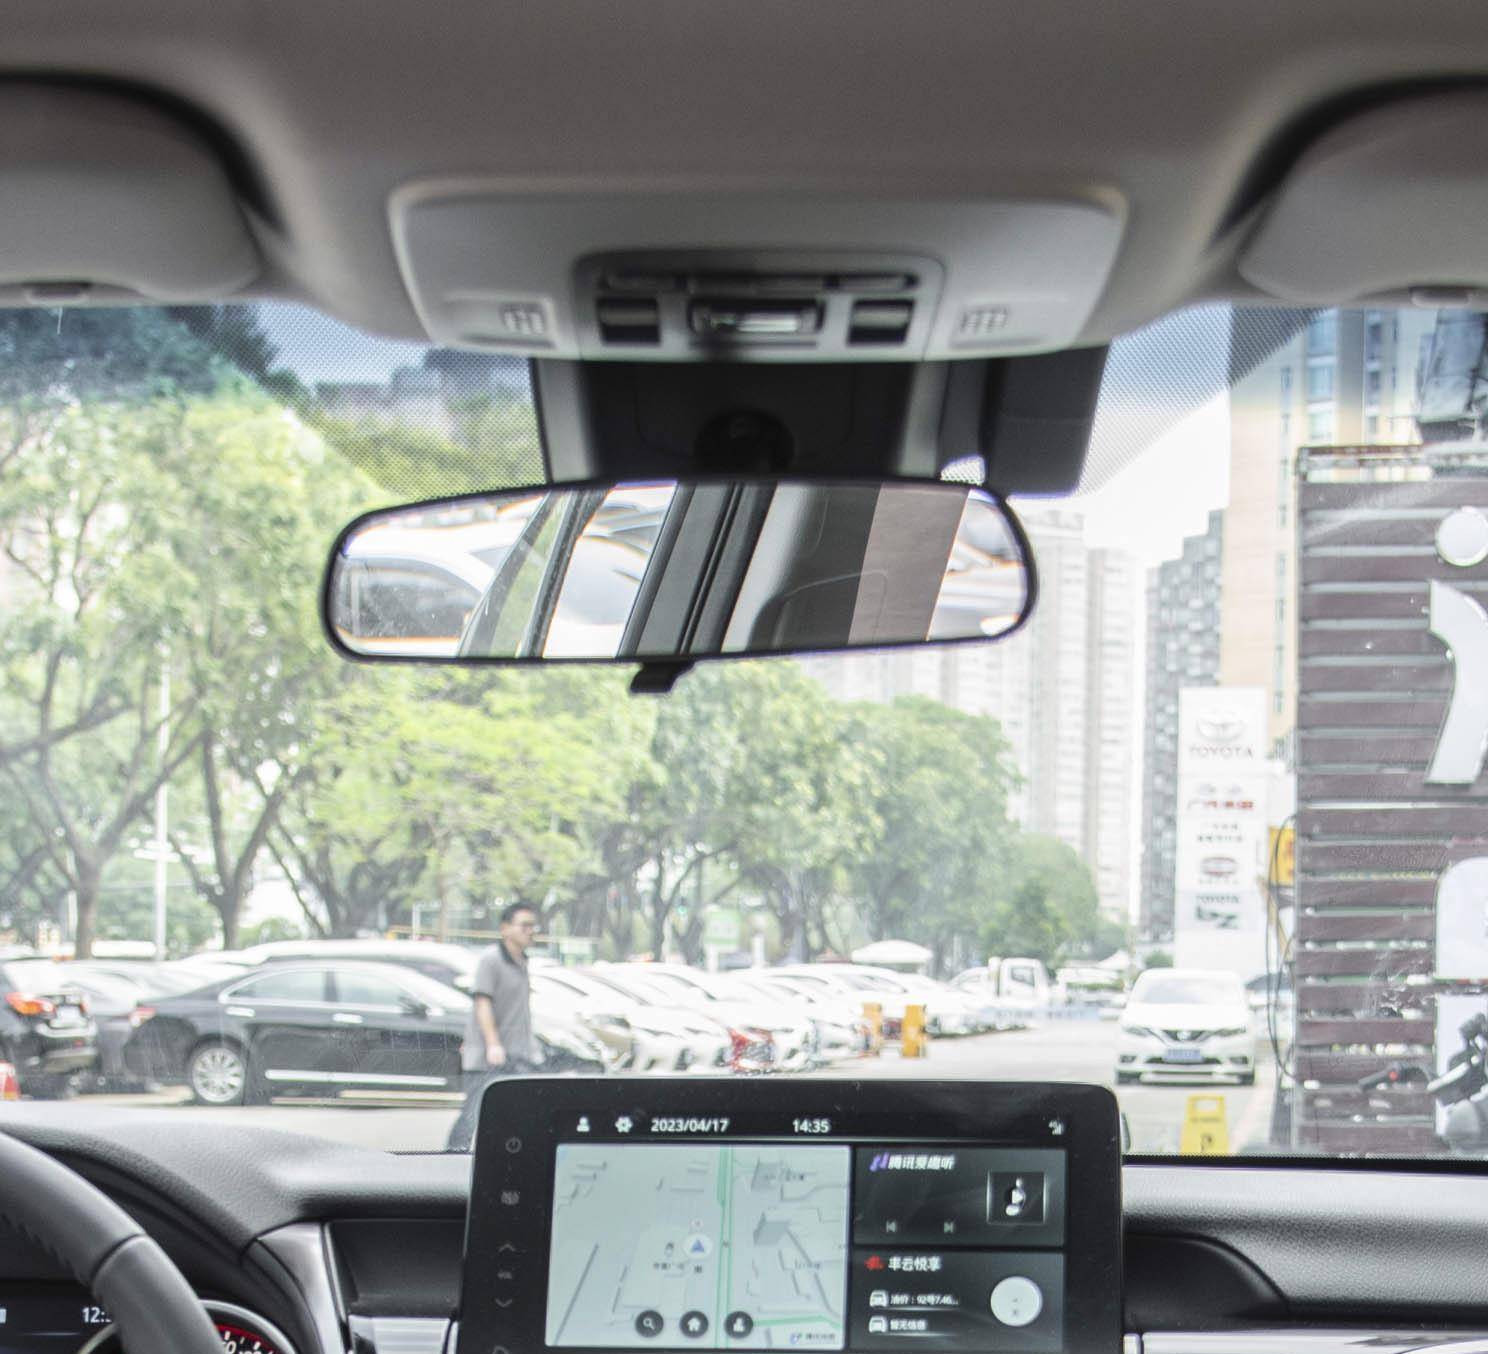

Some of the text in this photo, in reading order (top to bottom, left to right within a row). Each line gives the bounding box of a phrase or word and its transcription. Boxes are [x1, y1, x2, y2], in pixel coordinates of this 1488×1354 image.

[1189, 746, 1255, 759] TOYOTA
[650, 1118, 730, 1133] 2023/04/17
[792, 1119, 831, 1134] 14:35
